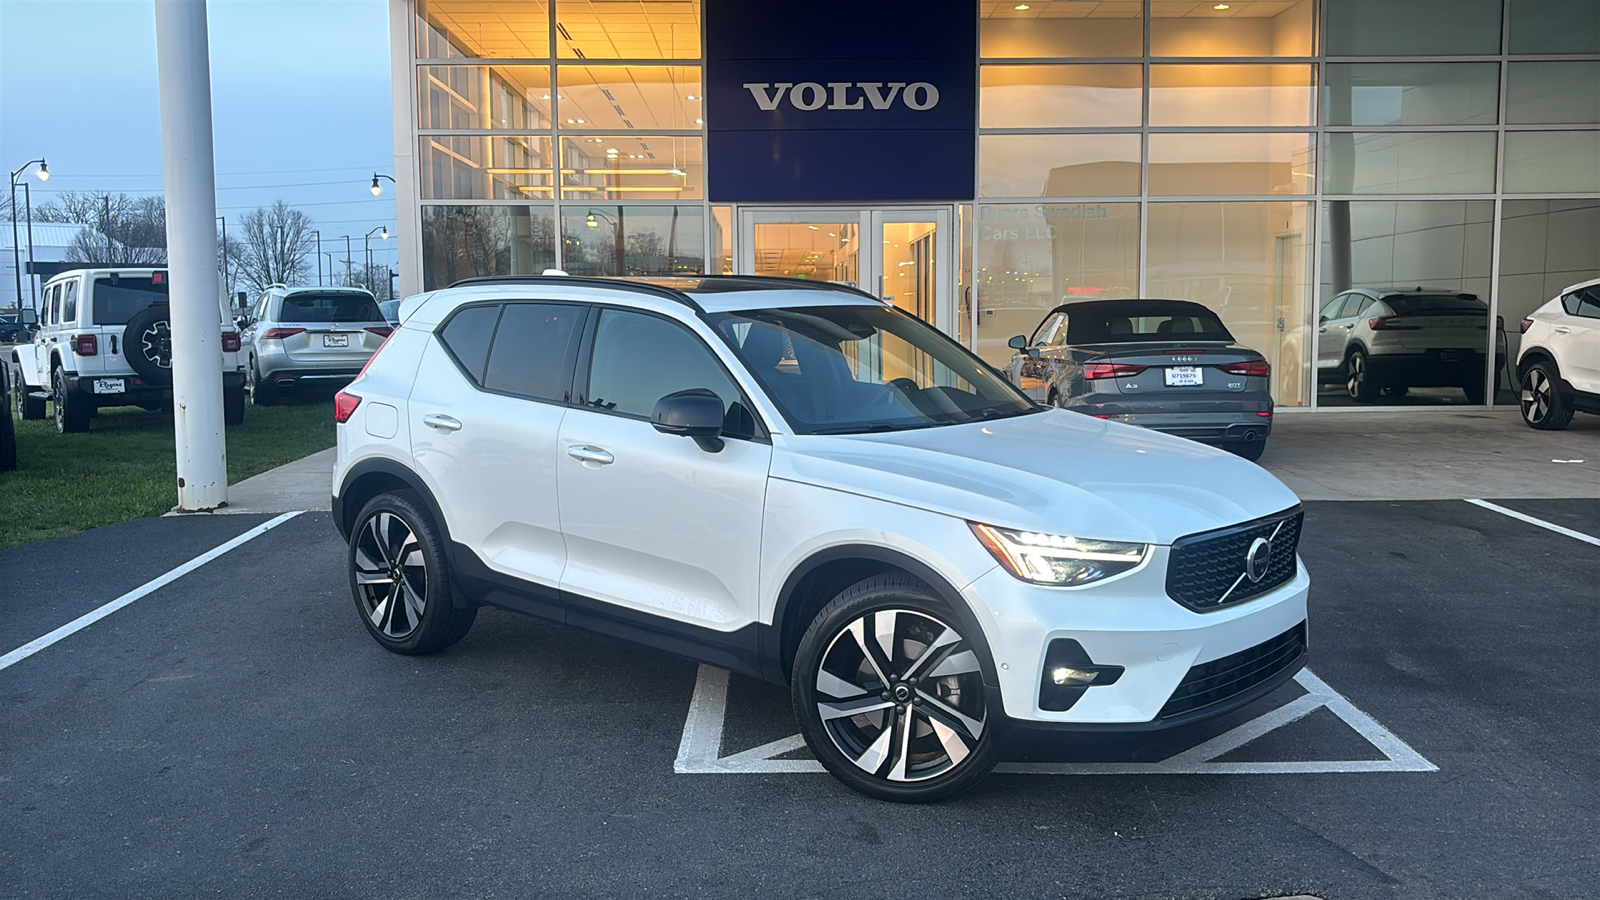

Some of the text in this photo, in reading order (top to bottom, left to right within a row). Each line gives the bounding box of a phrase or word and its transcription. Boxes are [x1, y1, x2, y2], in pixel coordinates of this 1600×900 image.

[743, 82, 940, 111] VOLVO
[980, 204, 1107, 223] Byers Swedish
[980, 224, 1058, 240] Cars LLC
